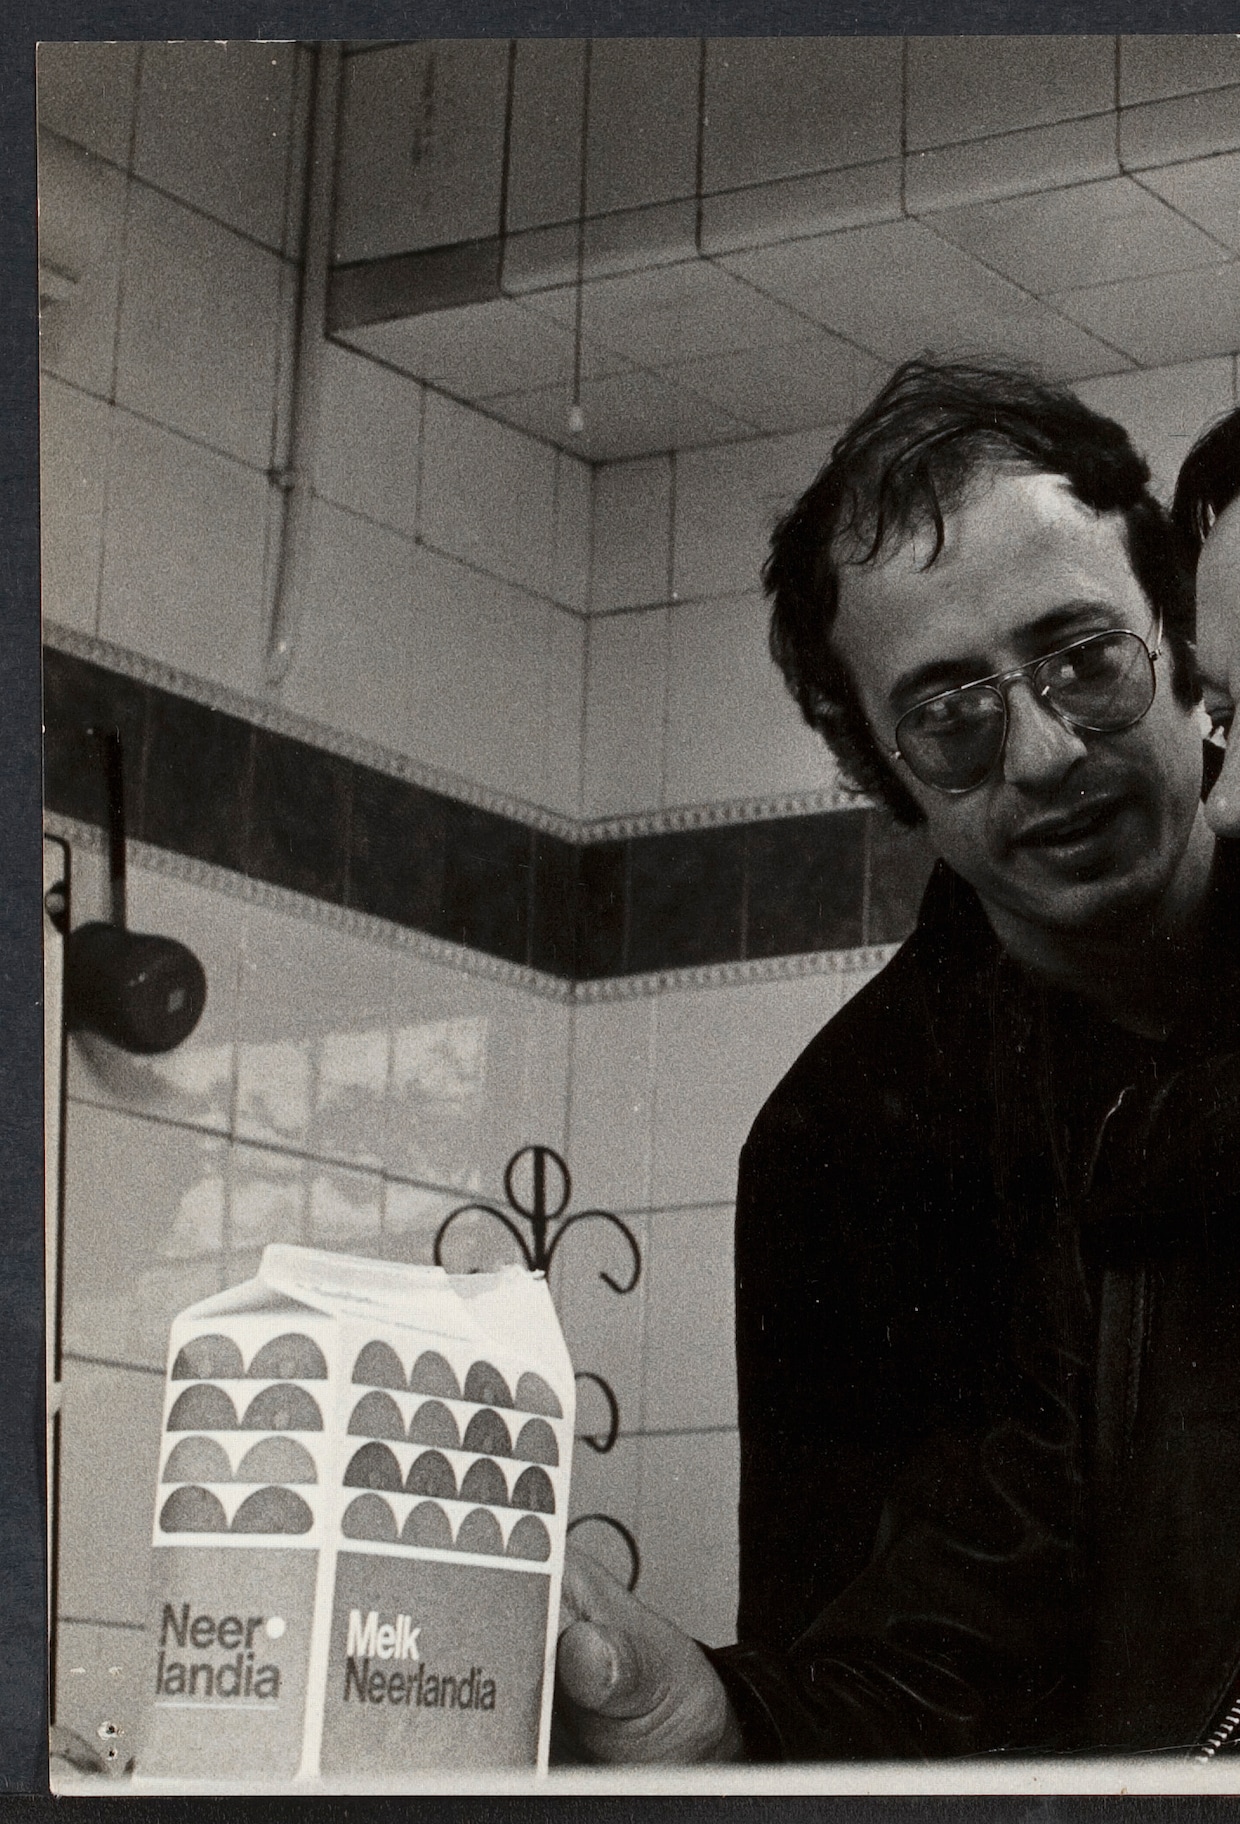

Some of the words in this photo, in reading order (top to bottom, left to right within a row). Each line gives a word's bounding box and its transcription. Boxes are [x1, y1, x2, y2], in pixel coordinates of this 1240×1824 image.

[160, 1602, 263, 1649] Neer
[347, 1609, 421, 1661] Melk
[155, 1650, 280, 1699] landia
[344, 1656, 496, 1710] Neerlandia
